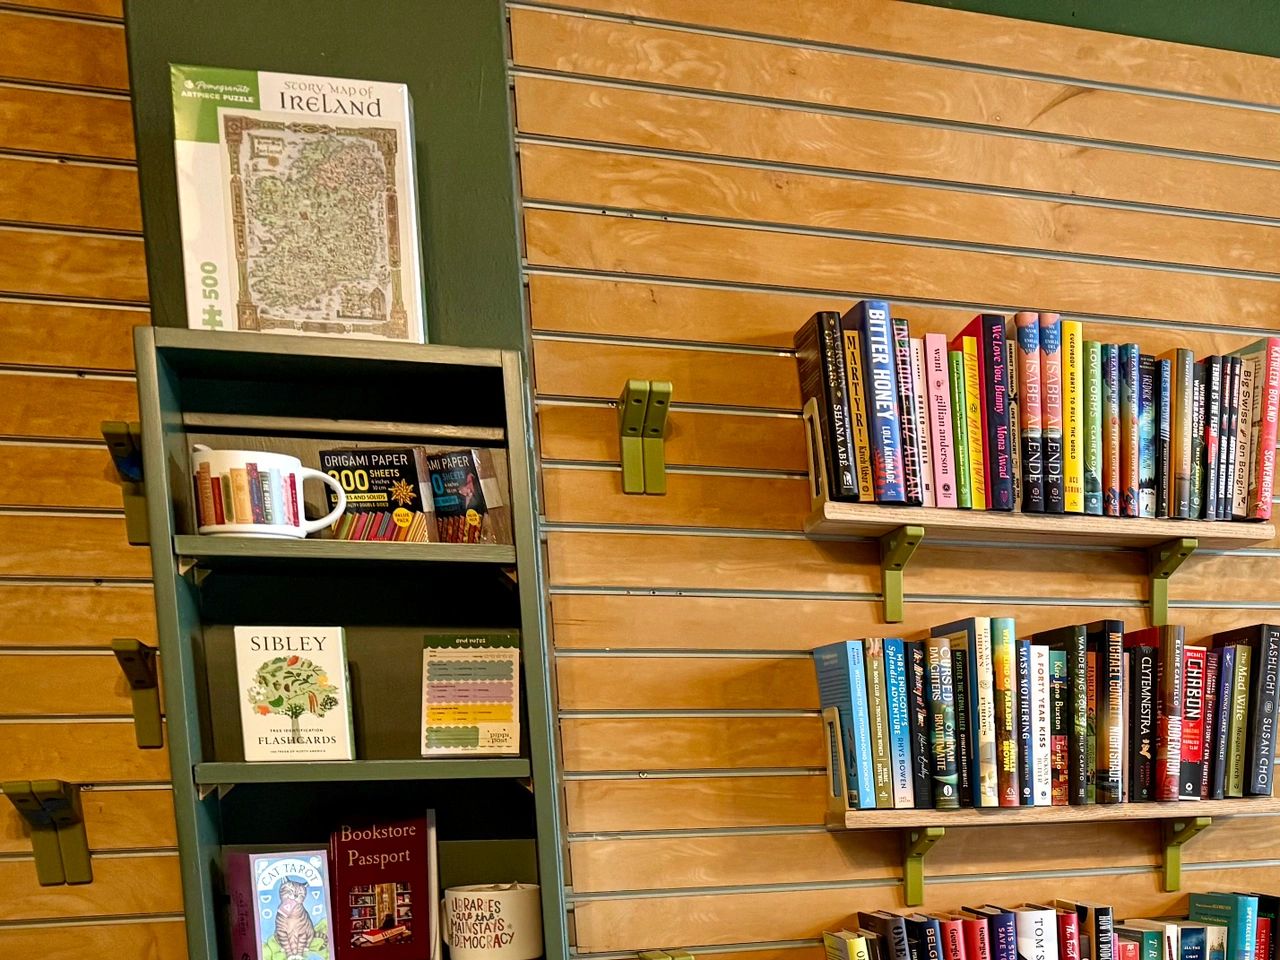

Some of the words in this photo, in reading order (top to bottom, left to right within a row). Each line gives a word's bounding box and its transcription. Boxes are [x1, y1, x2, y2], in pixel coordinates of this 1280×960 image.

[181, 91, 220, 100] ARTPIECE
[223, 94, 253, 103] PUZZLE
[280, 92, 381, 117] IRELAND
[201, 262, 218, 300] 500
[869, 309, 889, 363] BITTER
[934, 348, 943, 372] want
[1089, 348, 1097, 374] LOVE
[1026, 360, 1039, 412] ISABEL
[1046, 360, 1060, 412] ISABEL
[1242, 370, 1252, 388] Big
[873, 369, 894, 421] HONEY
[994, 385, 1005, 415] Bunny
[1089, 378, 1097, 417] FORMS
[1240, 391, 1250, 424] Swiss
[935, 394, 948, 427] gillian
[939, 429, 950, 474] anderson
[996, 426, 1007, 450] Mona
[1027, 414, 1041, 483] ALLENDE
[1047, 414, 1061, 483] ALLENDE
[325, 455, 369, 467] ORIGAMI
[372, 454, 408, 465] PAPER
[370, 469, 399, 477] SHEETS
[442, 456, 469, 468] PAPER
[998, 453, 1009, 478] Awad
[250, 636, 327, 651] SIBLEY
[1109, 633, 1122, 678] MICHAEL
[887, 646, 897, 684] Splendid
[1020, 648, 1028, 674] MASS
[1265, 631, 1279, 696] FLASHLIGHT
[1037, 663, 1045, 693] FORTY
[1184, 658, 1203, 721] CHABON
[1237, 666, 1247, 690] Mad
[891, 686, 901, 734] ADVENTURE
[1021, 679, 1030, 740] MOTHERING
[1140, 656, 1152, 735] CLYTEMNESTRA
[1235, 695, 1246, 721] Wife
[258, 736, 336, 744] FLASHCARDS
[897, 738, 905, 757] RHYS
[1167, 715, 1182, 776] MODERATION
[1260, 718, 1271, 754] SUSAN
[1108, 727, 1122, 782] NIGHTSHADE
[898, 760, 907, 789] BOWEN
[1257, 758, 1268, 788] CHOI
[341, 825, 416, 841] Bookstore
[261, 865, 282, 886] CAT
[284, 863, 319, 883] TAROT
[348, 850, 410, 869] Passport
[451, 918, 504, 935] MAINSTAYS
[456, 912, 472, 921] are
[474, 912, 494, 922] the
[455, 932, 514, 948] DEMOCRACY
[1034, 918, 1045, 960] TOM'S
